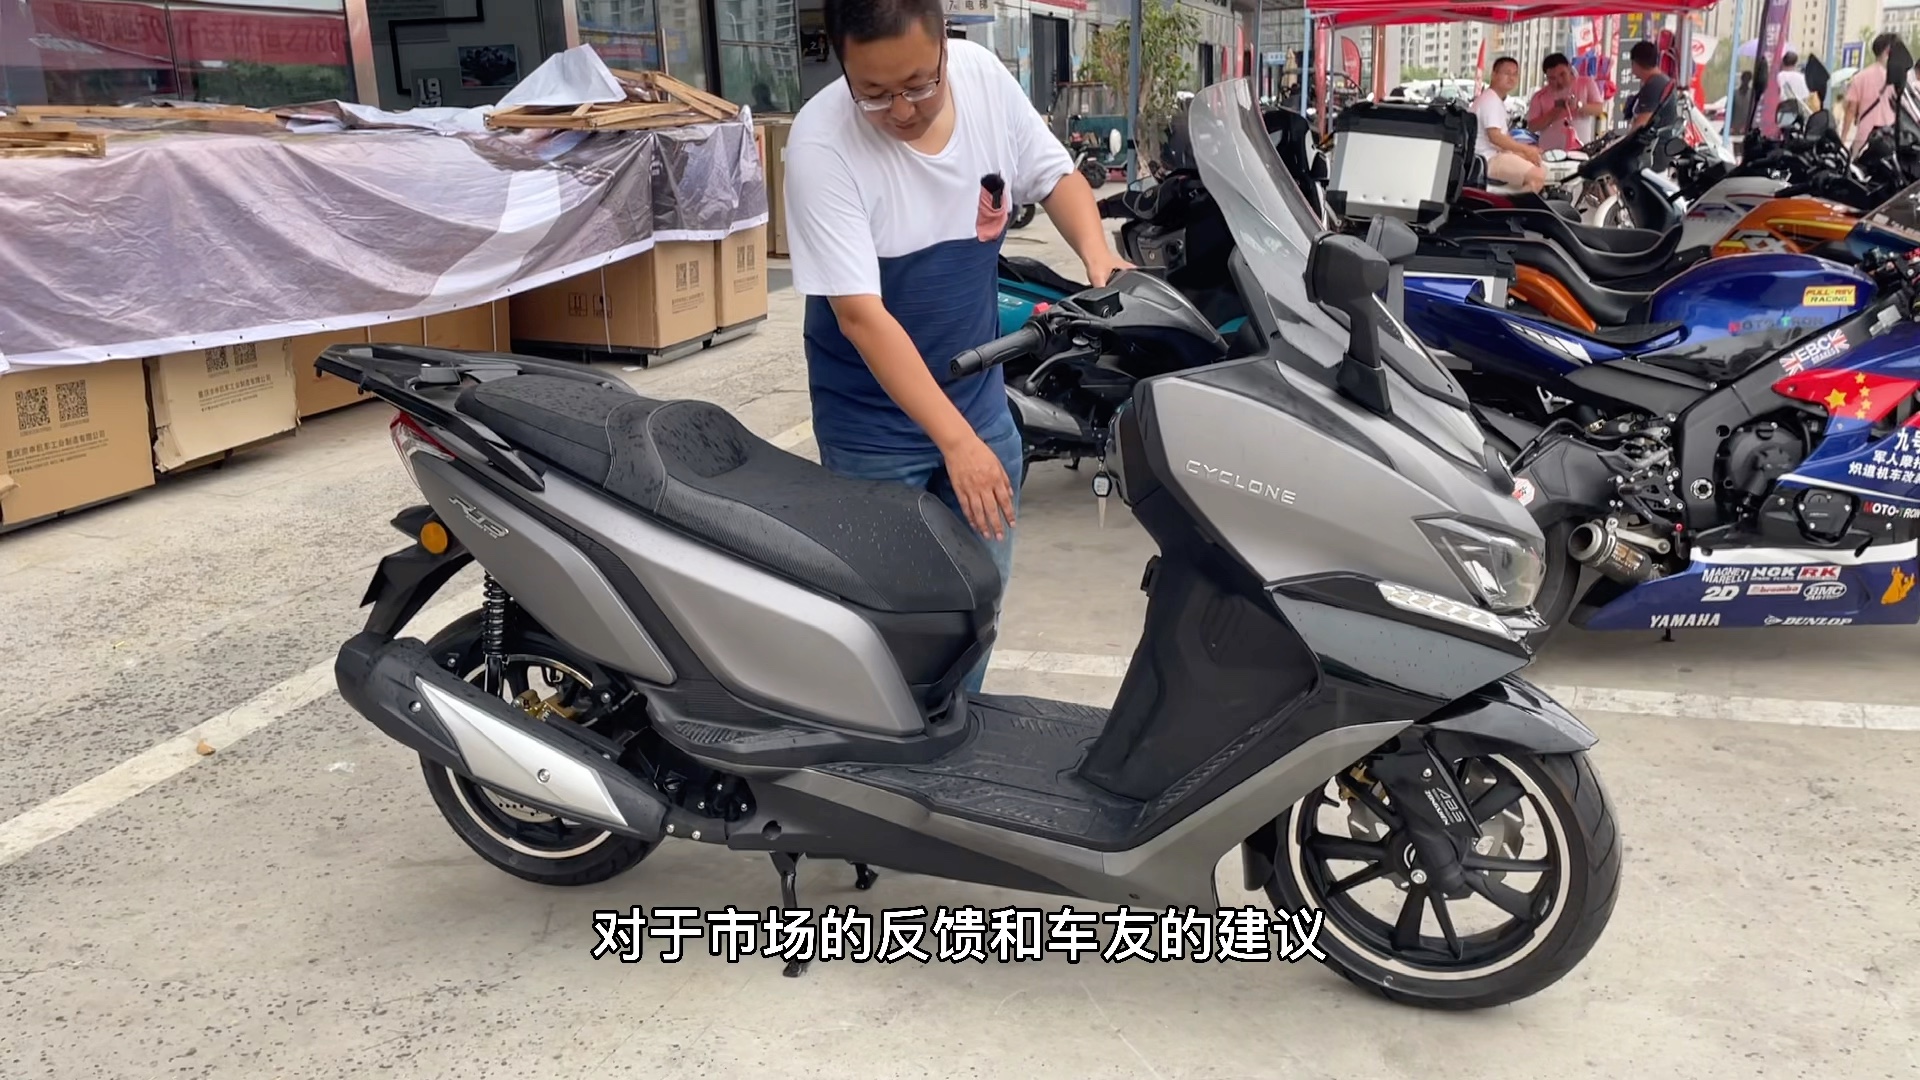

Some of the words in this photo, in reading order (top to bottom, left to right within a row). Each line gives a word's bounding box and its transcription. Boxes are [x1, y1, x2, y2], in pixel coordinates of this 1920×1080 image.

[1799, 337, 1832, 362] EBC
[1186, 459, 1297, 505] CYCLONE
[1751, 567, 1797, 577] NGK
[1800, 567, 1838, 577] RK
[1700, 585, 1740, 602] 2D
[1807, 585, 1843, 596] BMC
[1650, 613, 1721, 628] YAMAHA
[1781, 617, 1852, 626] DUNLOP
[1436, 787, 1466, 823] ABS
